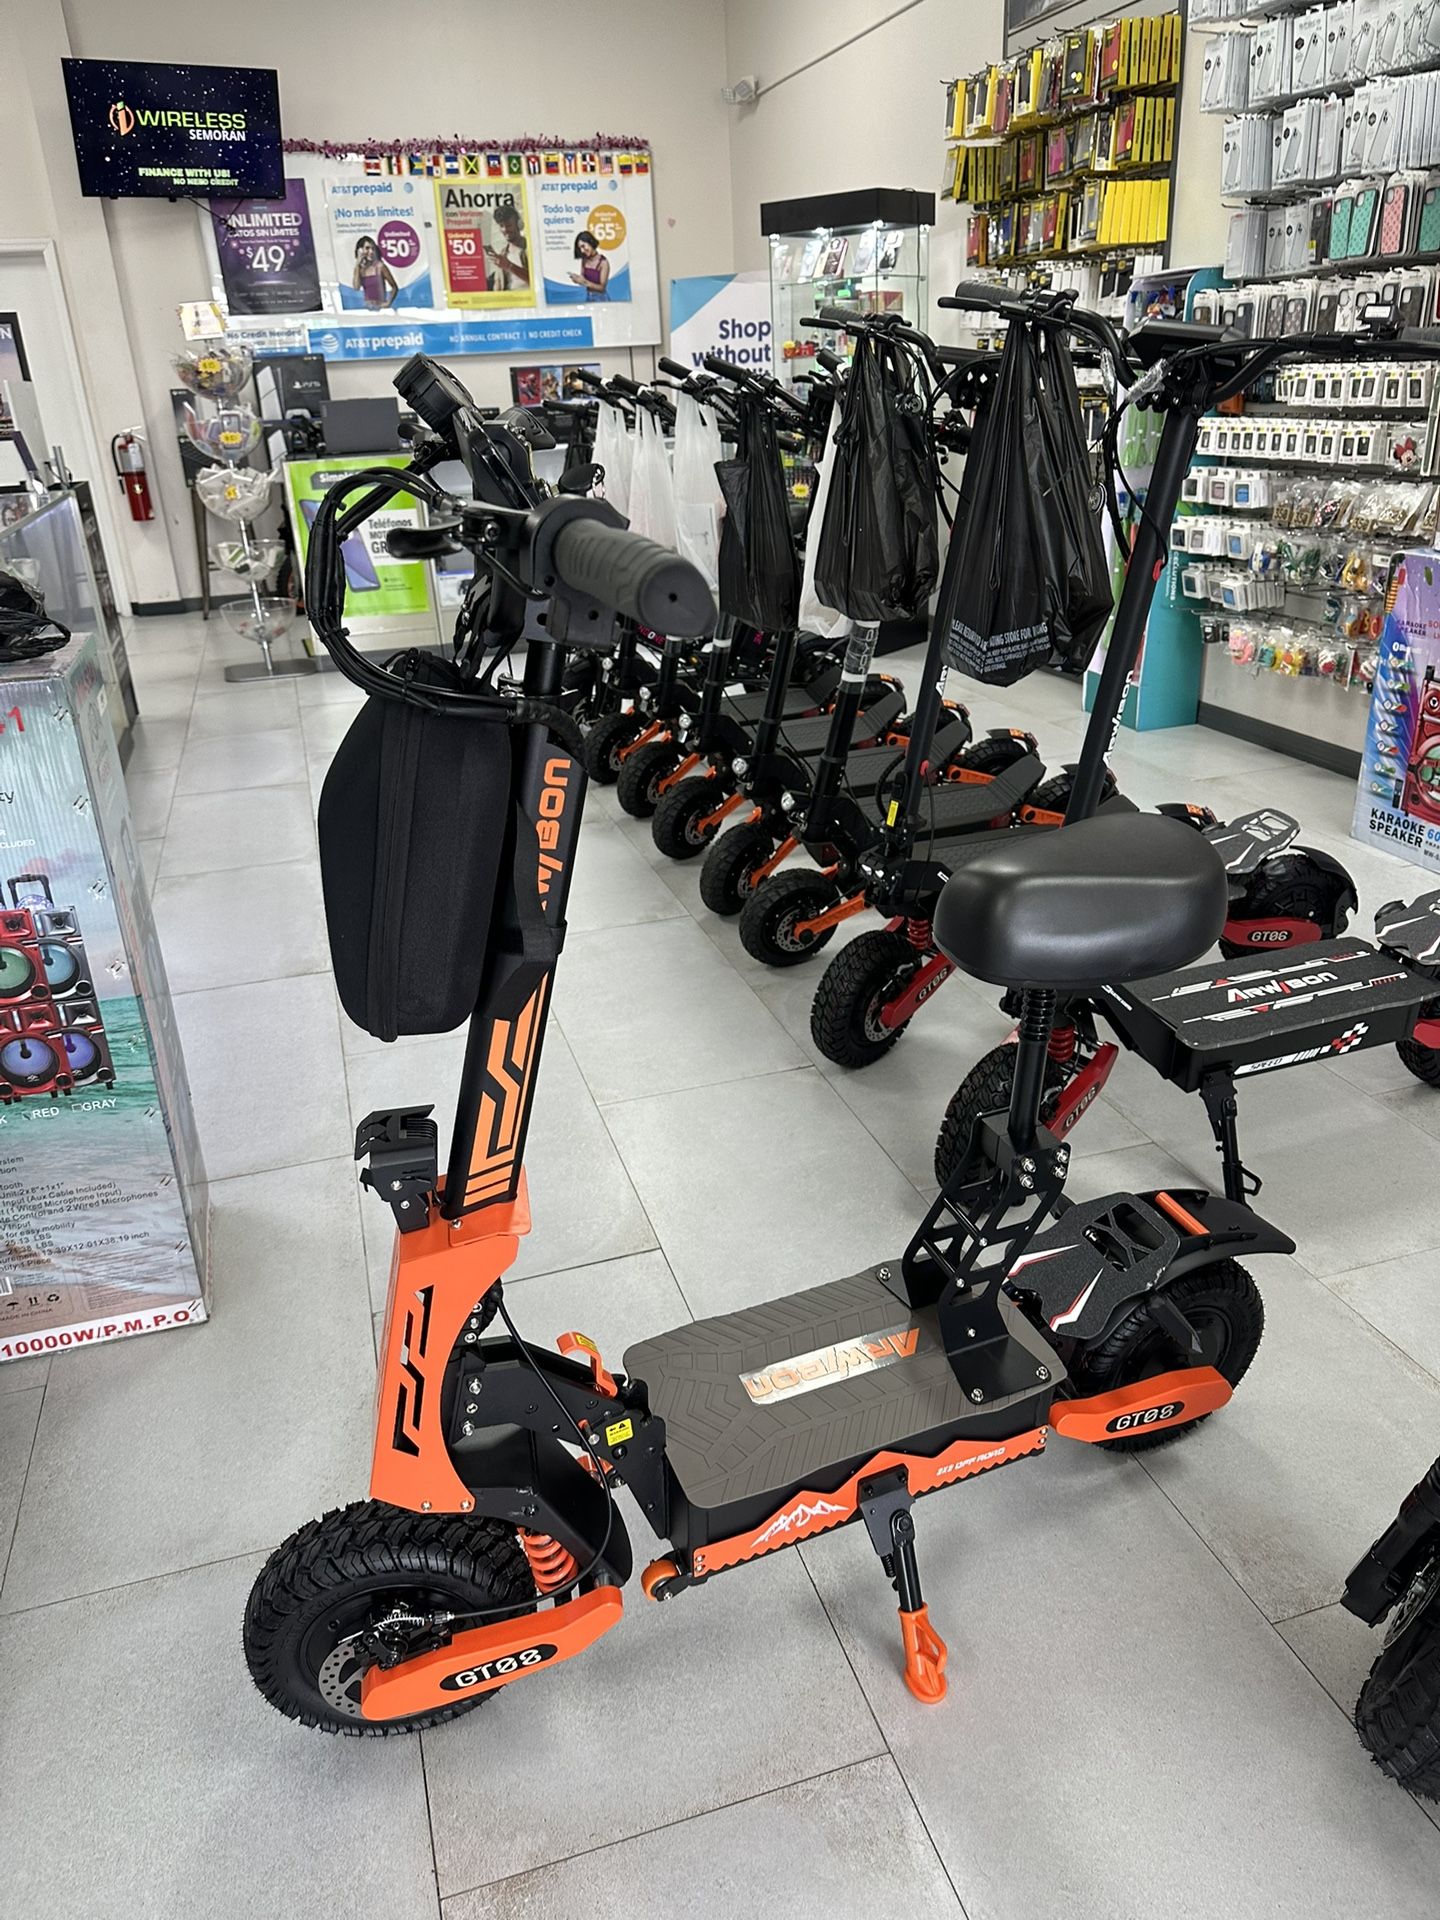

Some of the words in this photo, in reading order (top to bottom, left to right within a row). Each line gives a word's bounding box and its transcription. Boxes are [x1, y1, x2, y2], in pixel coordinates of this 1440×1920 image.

[138, 167, 184, 178] FINANCE
[185, 168, 212, 178] WITH
[445, 188, 515, 208] Ahorra
[542, 205, 564, 214] Todo
[565, 204, 573, 213] lo
[574, 205, 590, 214] que
[225, 213, 303, 228] NLIMITED
[487, 332, 521, 342] CONTRACT
[528, 331, 538, 339] NO
[539, 330, 562, 338] CREDIT
[562, 328, 583, 338] CHECK
[719, 318, 772, 342] Shop
[372, 333, 424, 352] prepaid
[692, 344, 772, 367] without
[368, 517, 413, 530] Teléfonos
[1371, 808, 1426, 836] KARAOKE
[1369, 819, 1423, 848] SPEAKER
[32, 1106, 60, 1119] RED
[82, 1098, 117, 1111] GRAY
[44, 1195, 95, 1208] Microphone
[96, 1188, 122, 1199] Input)
[48, 1190, 75, 1199] Cable
[75, 1182, 117, 1194] Included)
[101, 1190, 159, 1206] Microphones
[6, 1231, 18, 1239] for
[41, 1222, 76, 1233] mobility
[34, 1232, 52, 1242] LBS
[131, 1231, 150, 1240] inch
[36, 1240, 54, 1250] LBS
[1116, 1404, 1175, 1430] GT08
[455, 1648, 542, 1688] GT08
